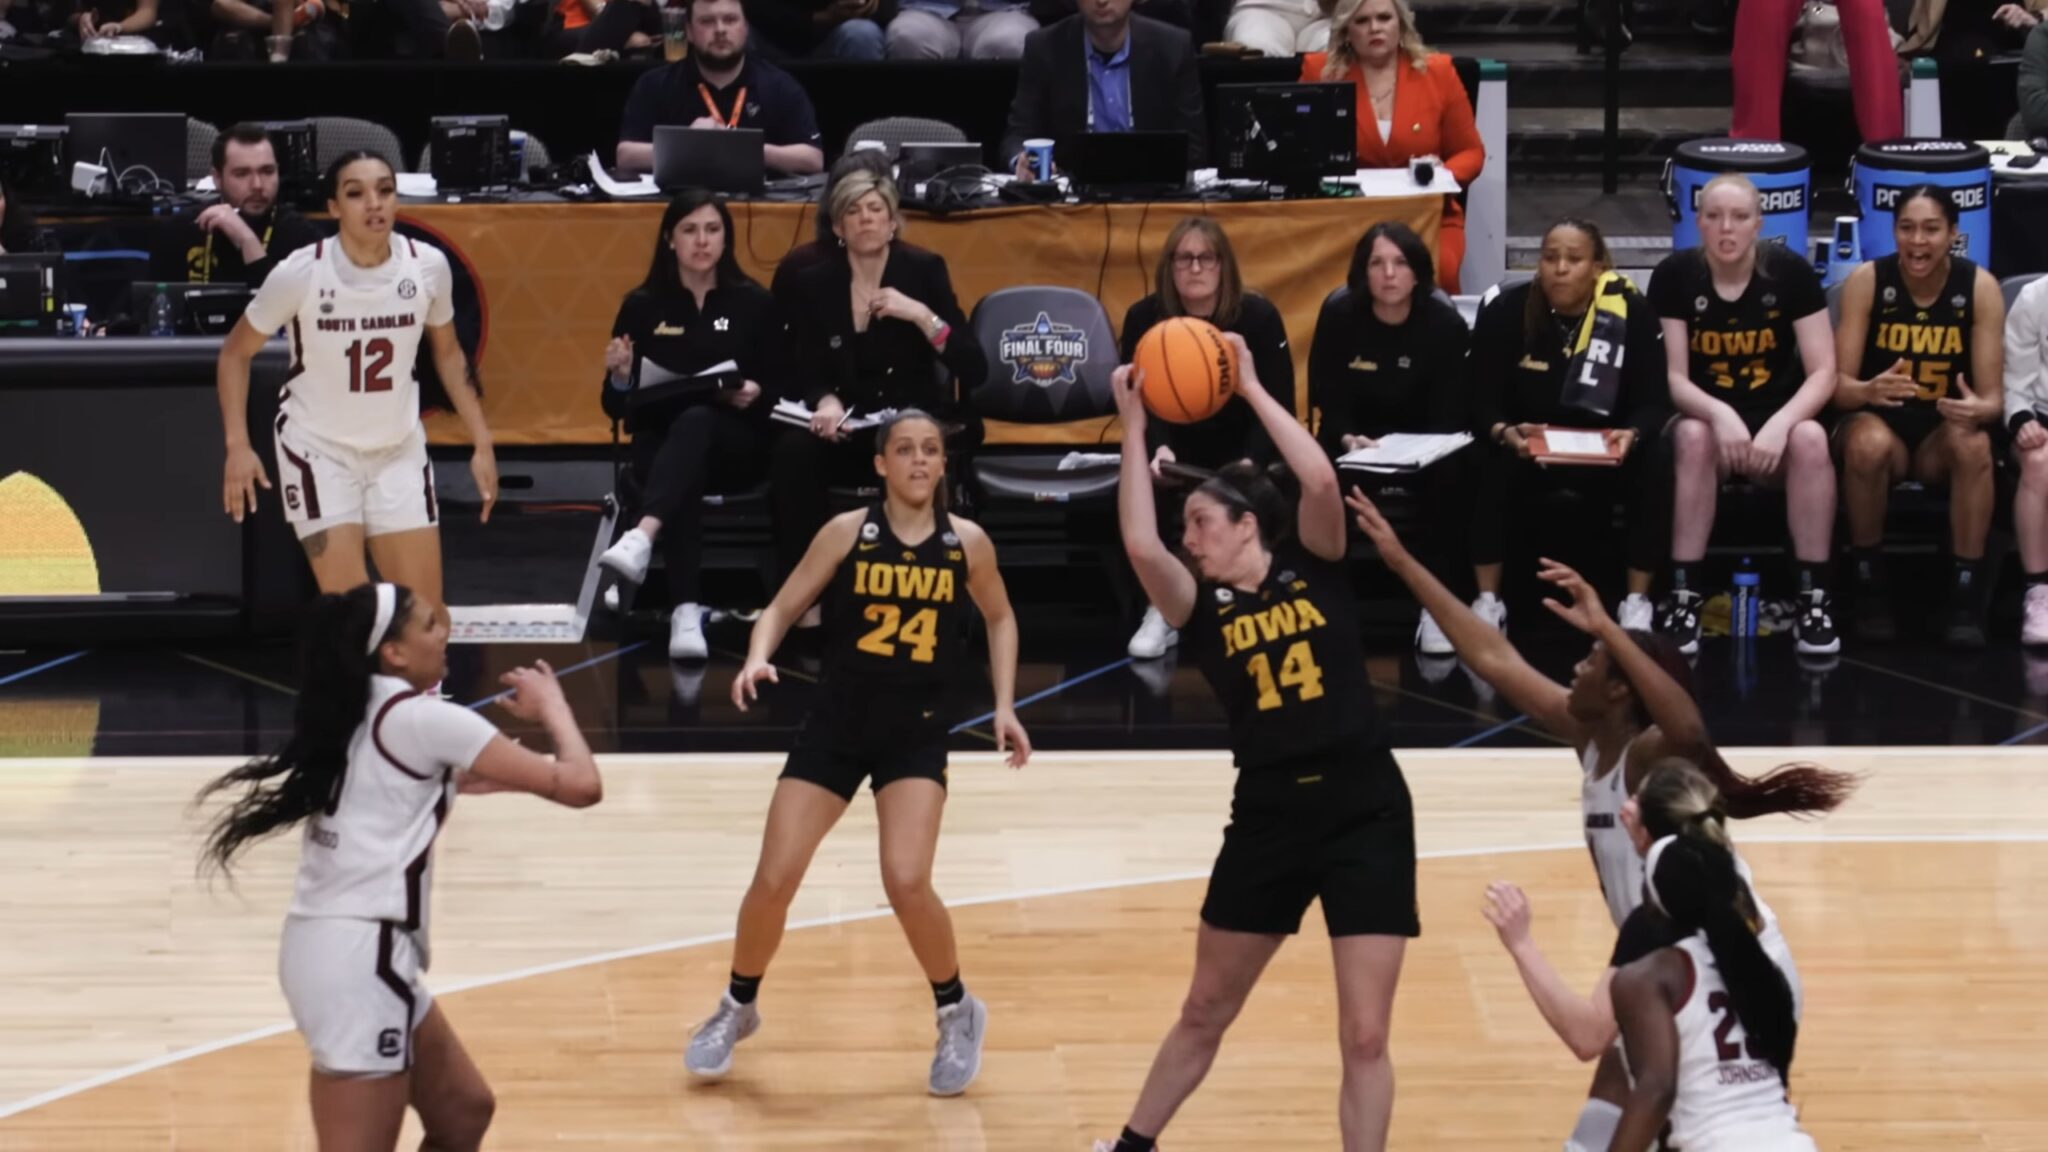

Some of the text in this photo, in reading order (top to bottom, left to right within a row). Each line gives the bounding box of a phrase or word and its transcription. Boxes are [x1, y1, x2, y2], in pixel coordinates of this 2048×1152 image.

[317, 312, 415, 332] SOUTH CAROLINA
[1876, 322, 1963, 354] IOWA
[345, 337, 394, 393] 12
[1003, 340, 1084, 358] FINAL FOUR
[854, 561, 954, 602] IOWA
[856, 603, 938, 663] 24
[1221, 598, 1327, 657] IOWA
[1247, 640, 1324, 711] 14
